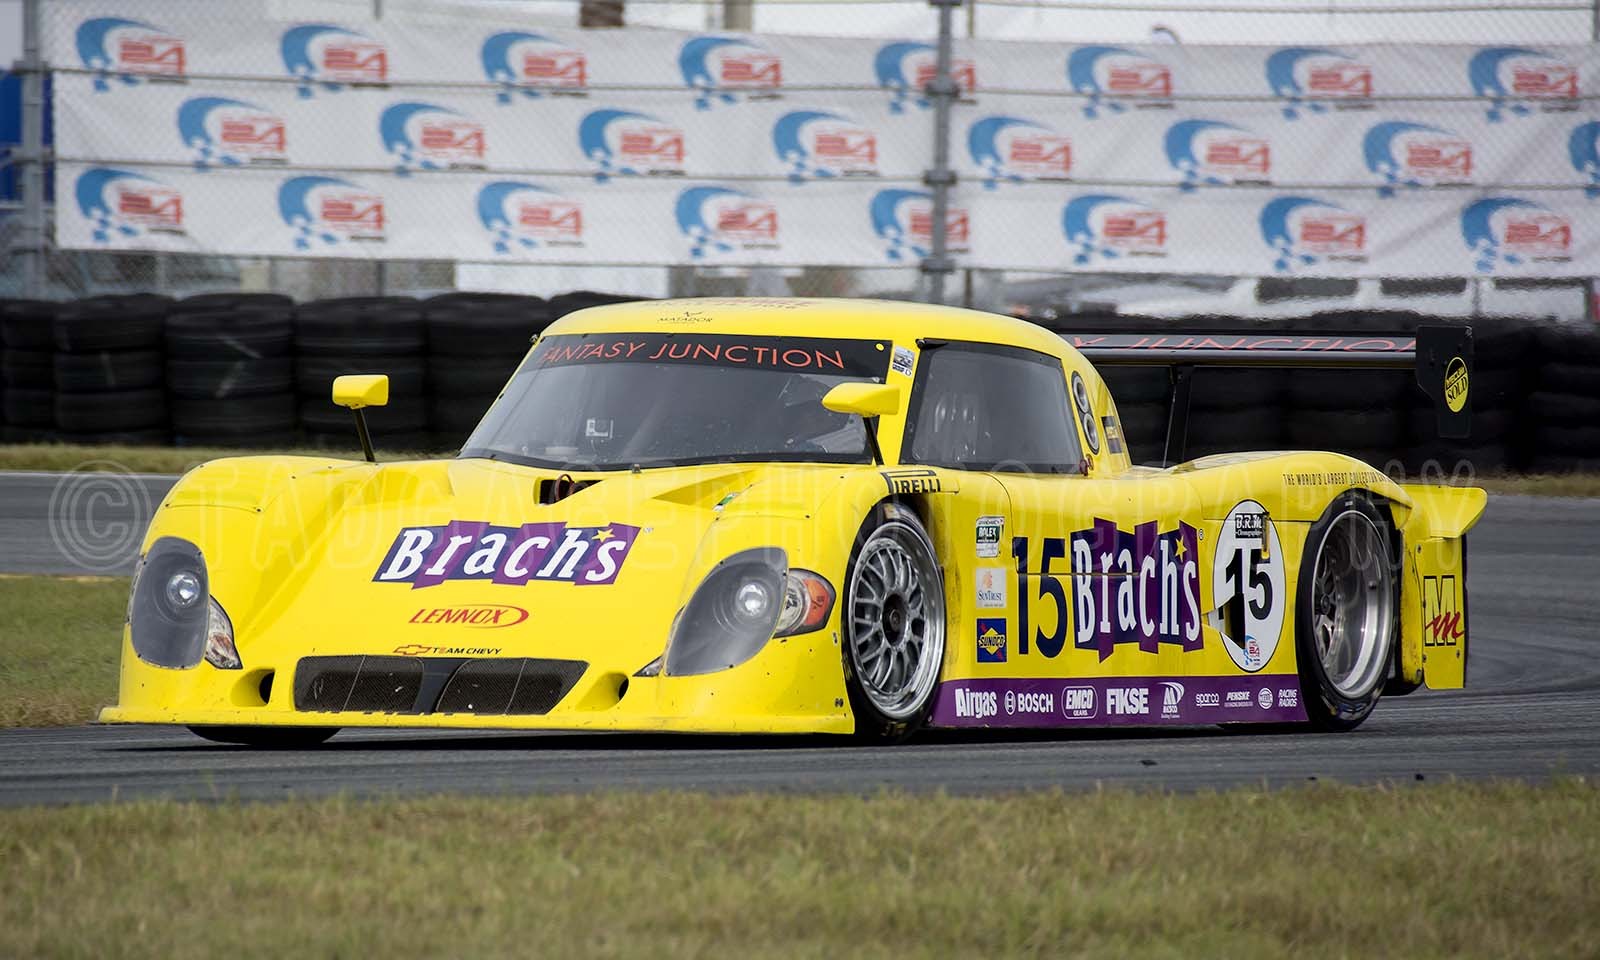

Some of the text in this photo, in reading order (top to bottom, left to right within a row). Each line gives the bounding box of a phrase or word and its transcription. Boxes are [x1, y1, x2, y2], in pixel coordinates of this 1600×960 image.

[537, 342, 845, 369] FANTASY JUNCTION
[1447, 376, 1468, 402] SOLD
[880, 469, 941, 494] PIRELLI
[1283, 473, 1295, 486] THE
[979, 527, 997, 537] ROLEX
[380, 528, 627, 582] Brach's
[1073, 538, 1201, 643] Brach's
[1218, 548, 1273, 621] 15
[1011, 536, 1068, 659] 15
[408, 609, 509, 624] LENNOX
[433, 646, 502, 655] TEAM CHEVY
[979, 634, 1006, 647] SUNOCO
[955, 688, 998, 718] Airgas
[1018, 693, 1054, 713] BOSCH
[1065, 689, 1094, 710] EMCO
[1106, 688, 1149, 715] FIKSE
[1196, 693, 1220, 704] sparco
[1226, 691, 1250, 701] PENSKE
[1278, 689, 1298, 698] RACING
[1278, 698, 1298, 707] RADIOS
